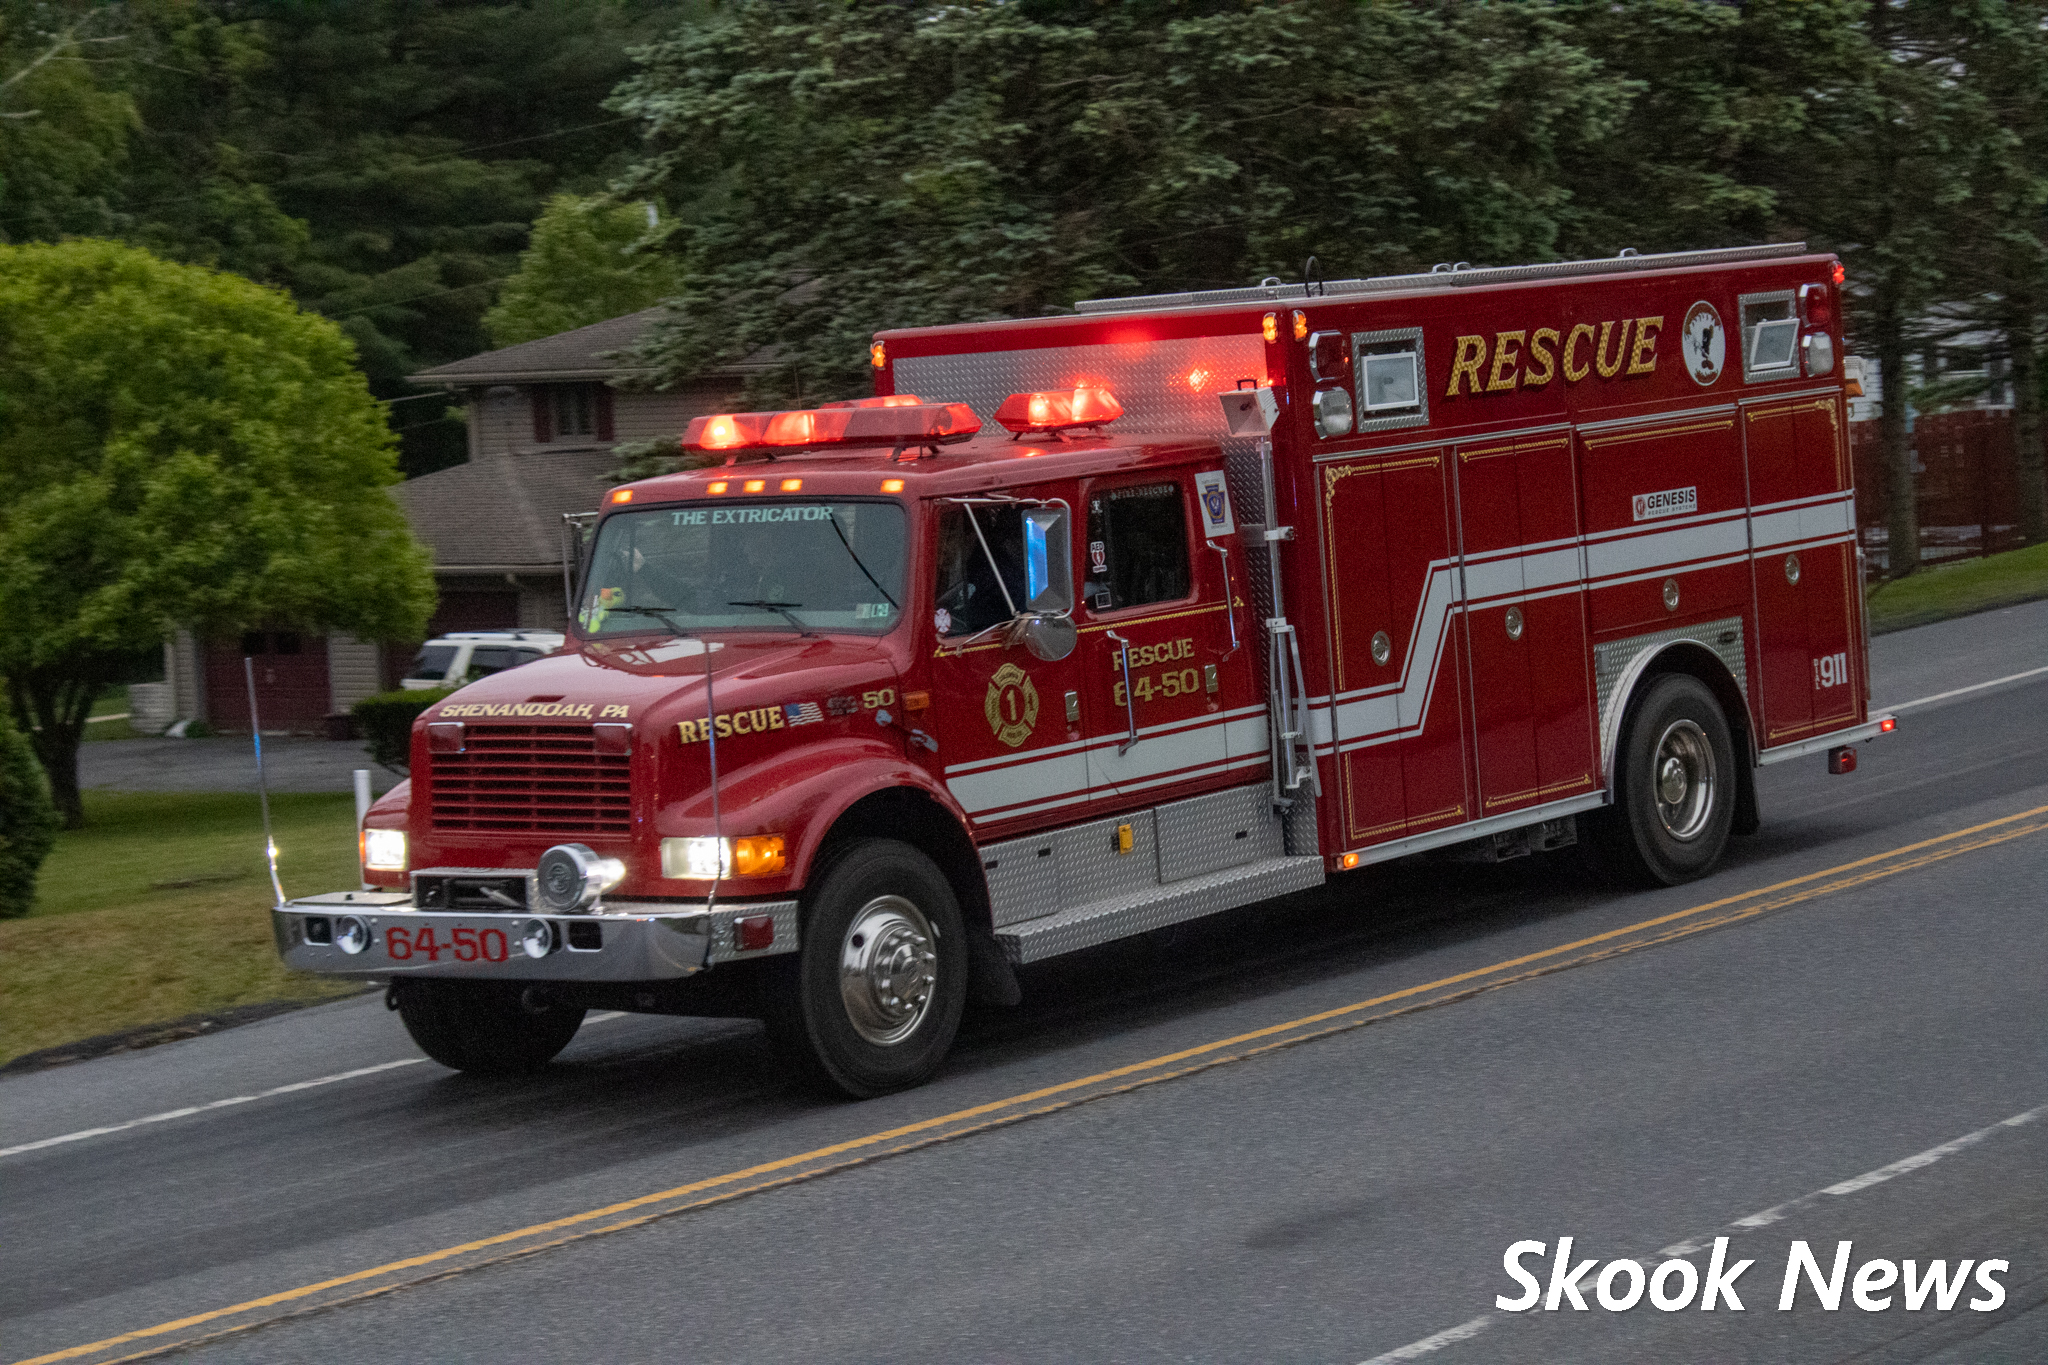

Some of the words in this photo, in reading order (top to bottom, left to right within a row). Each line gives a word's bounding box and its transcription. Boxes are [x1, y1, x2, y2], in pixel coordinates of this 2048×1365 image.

[1446, 316, 1664, 396] RESCUE
[1647, 489, 1695, 509] GENESIS
[672, 511, 707, 526] THE
[712, 506, 834, 524] EXTRICATOR
[1112, 638, 1195, 671] RESCUE
[1820, 652, 1848, 688] 911
[862, 689, 895, 709] 50
[1113, 668, 1199, 706] 64-50
[439, 703, 595, 719] SHENANDOAH,
[599, 705, 629, 718] PA
[1006, 689, 1017, 721] 1
[678, 706, 784, 744] RESCUE
[386, 926, 509, 962] 64-50
